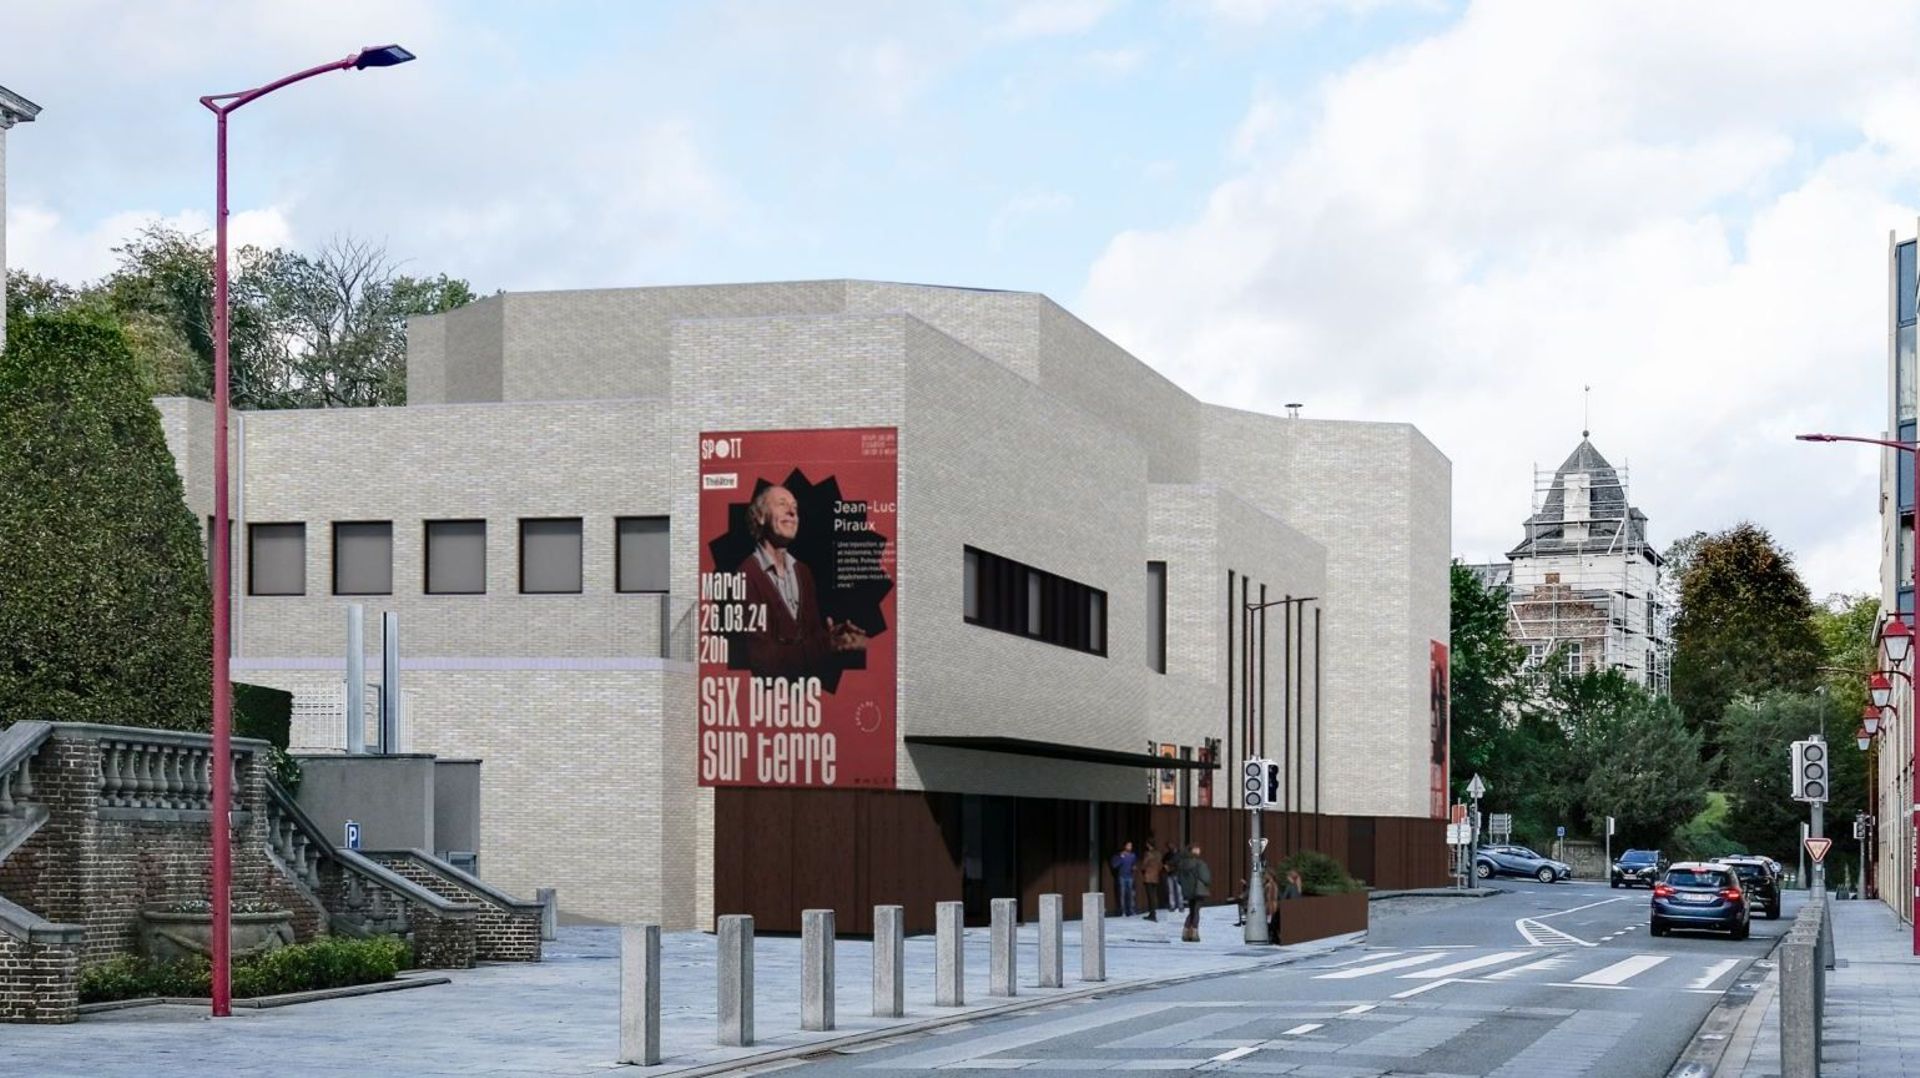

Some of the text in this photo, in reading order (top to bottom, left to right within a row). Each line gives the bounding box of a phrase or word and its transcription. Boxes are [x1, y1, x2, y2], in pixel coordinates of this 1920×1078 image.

[834, 501, 896, 513] Jean-Luc
[834, 519, 875, 531] Piraux
[702, 572, 746, 600] Mardi
[701, 604, 767, 632] 26.03.24
[700, 635, 728, 663] 20h
[758, 732, 836, 785] terre
[348, 826, 357, 848] P
